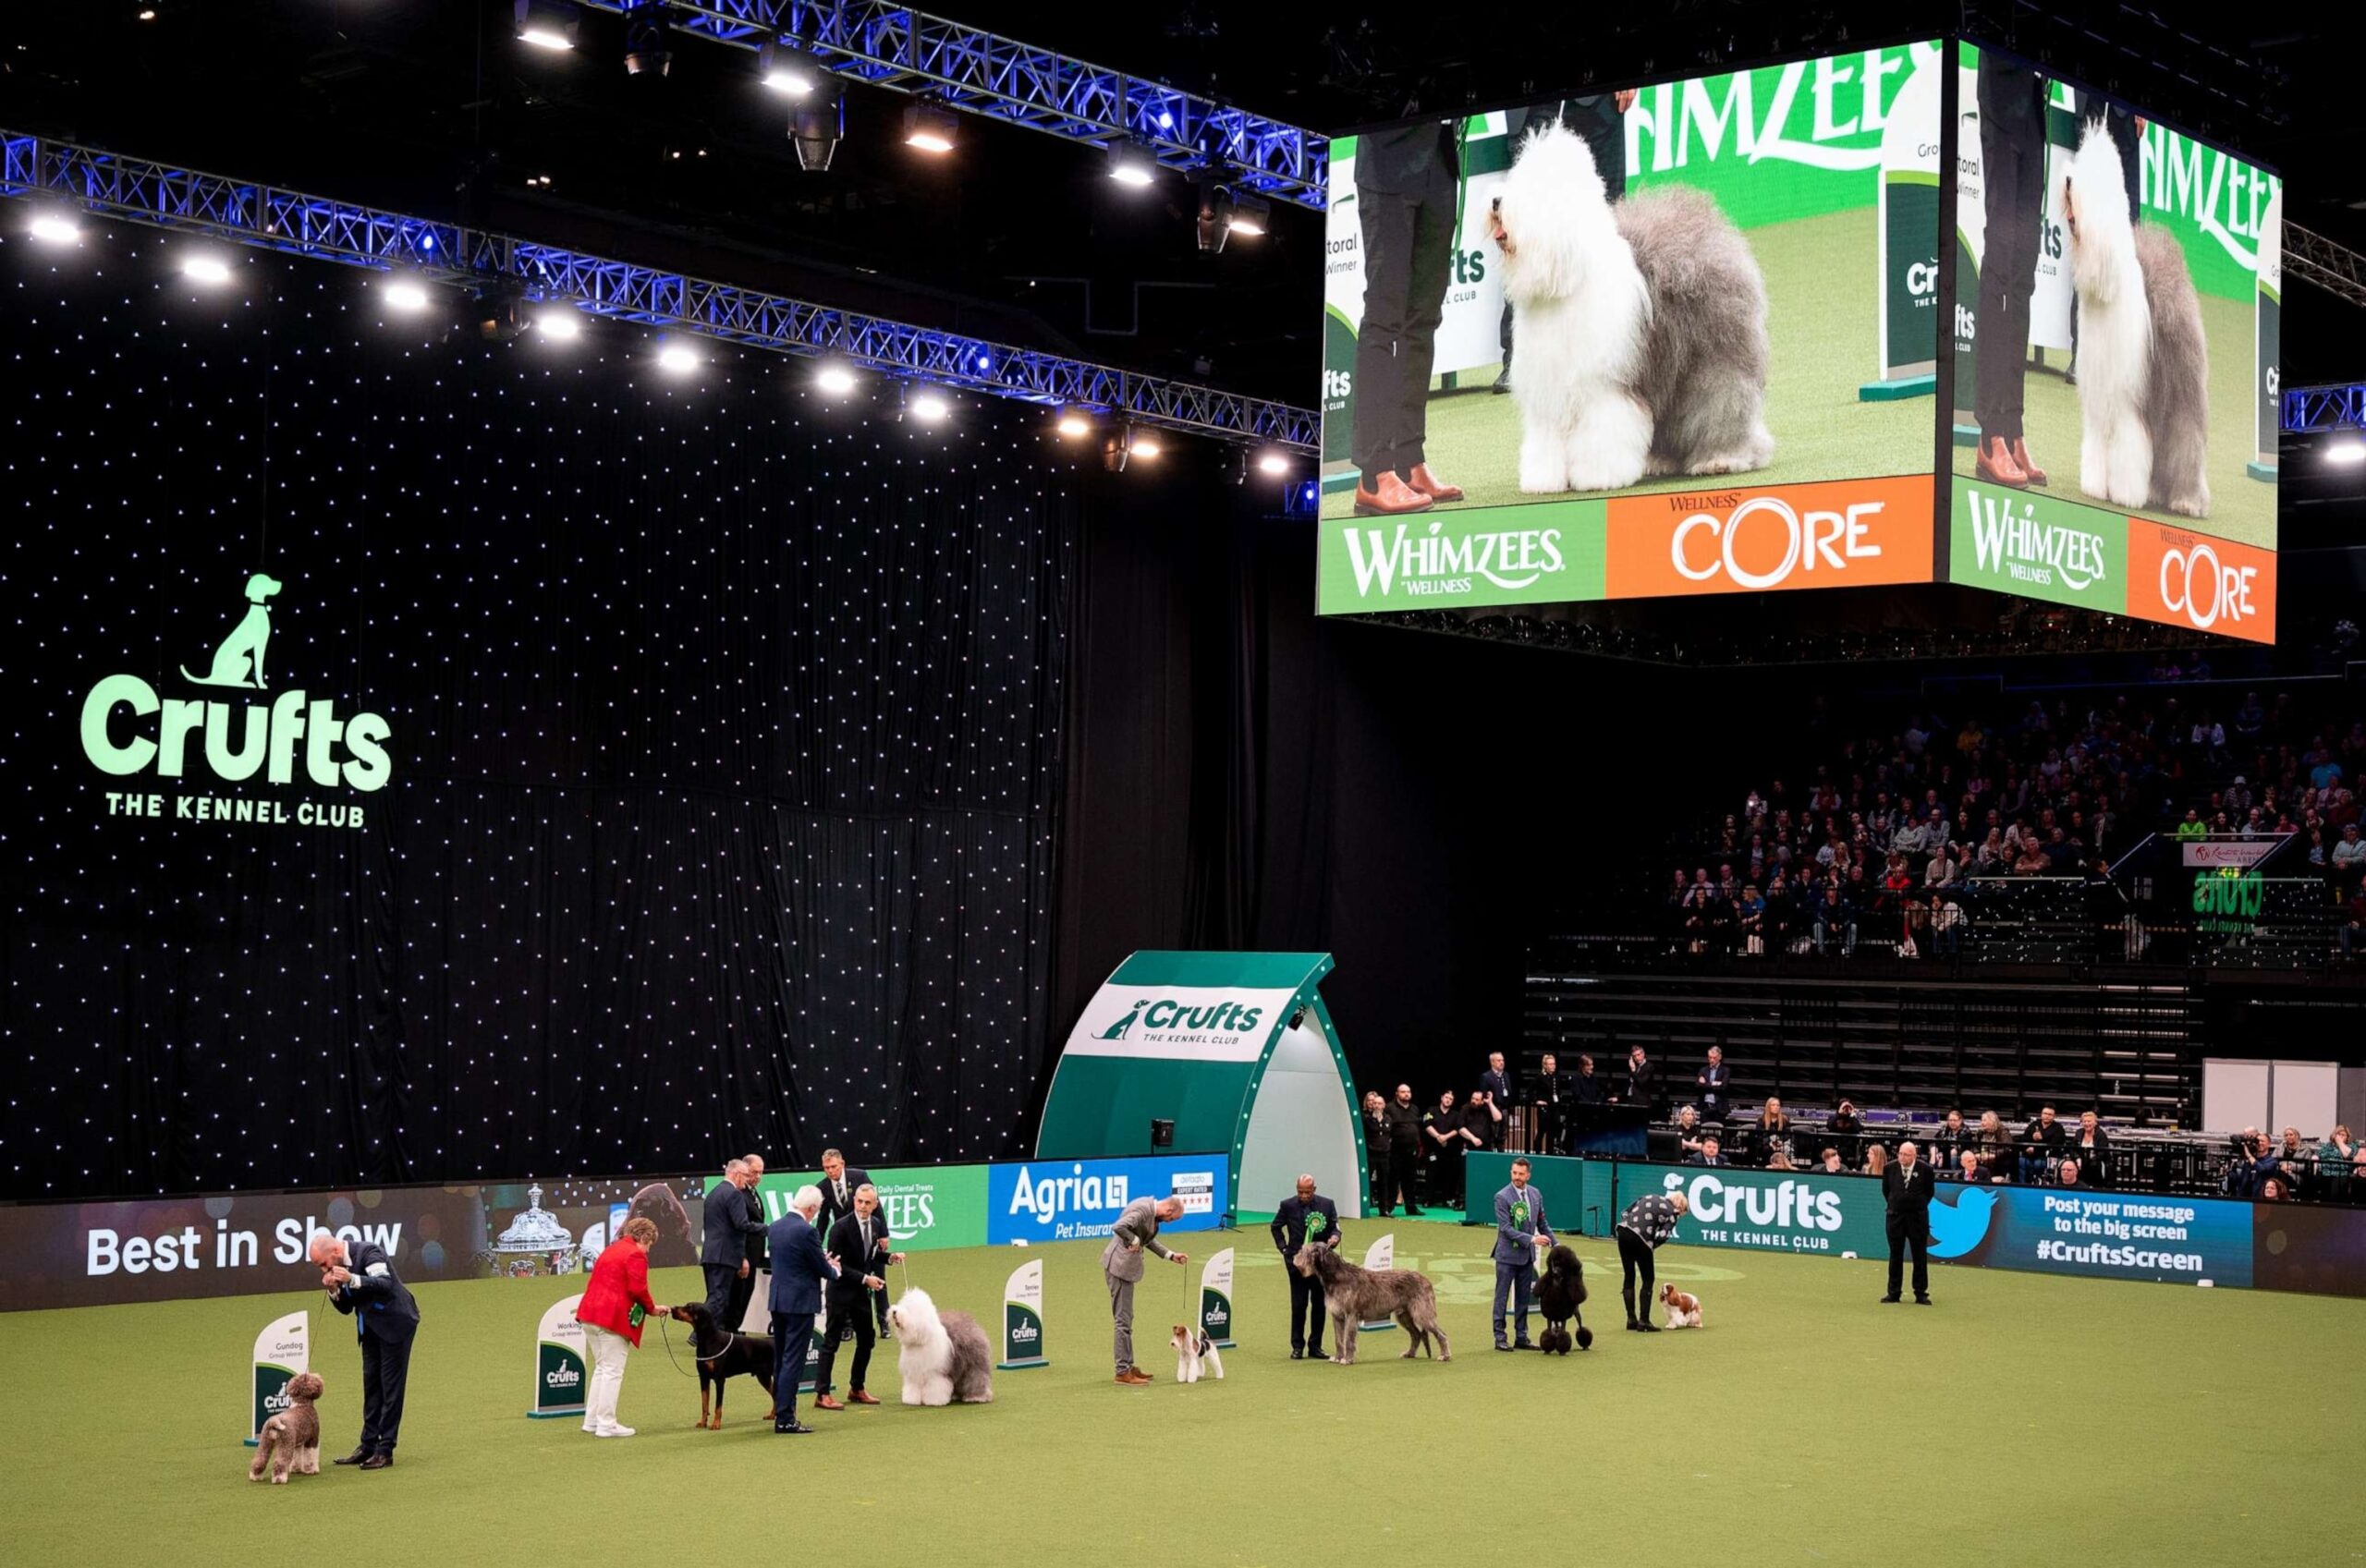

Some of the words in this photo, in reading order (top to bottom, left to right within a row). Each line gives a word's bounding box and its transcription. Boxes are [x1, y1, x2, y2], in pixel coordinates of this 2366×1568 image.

[1454, 290, 1477, 303] CLUB
[1914, 297, 1930, 309] THE
[1669, 492, 1738, 512] WELLNESS
[1671, 496, 1882, 589] CORE
[1968, 490, 2104, 590] WHIMZEES
[1343, 522, 1564, 598] WHIMZEES
[1406, 577, 1472, 596] WELLNESS
[2160, 543, 2257, 628] CORE
[80, 674, 392, 792] Crufts
[105, 792, 163, 817] THE
[177, 796, 288, 823] KENNEL
[298, 802, 365, 829] CLUB
[1144, 1000, 1262, 1032] Crufts
[1143, 1033, 1165, 1042] THE
[1166, 1034, 1207, 1043] KENNEL
[1212, 1036, 1239, 1045] CLUB
[878, 1185, 894, 1195] Daily
[894, 1184, 914, 1193] Dental
[915, 1183, 933, 1191] Treats
[1009, 1163, 1103, 1224] Agria
[1688, 1174, 1843, 1232] Crufts
[2044, 1196, 2080, 1213] Post
[2082, 1200, 2120, 1217] your
[2123, 1204, 2194, 1224] message
[1055, 1222, 1074, 1239] Pet
[1701, 1229, 1727, 1242] THE
[1734, 1232, 1787, 1246] KENNEL
[1793, 1235, 1829, 1249] CLUB
[2055, 1217, 2072, 1233] to
[2074, 1217, 2102, 1234] the
[2104, 1220, 2130, 1240] big
[2132, 1224, 2188, 1240] screen
[87, 1226, 201, 1276] Best
[216, 1219, 258, 1268] in
[2037, 1240, 2202, 1271] #CruftsScreen
[1205, 1311, 1227, 1322] Crufts
[1012, 1328, 1038, 1340] Crufts
[275, 1342, 303, 1351] Gundog
[547, 1371, 579, 1384] Crufts
